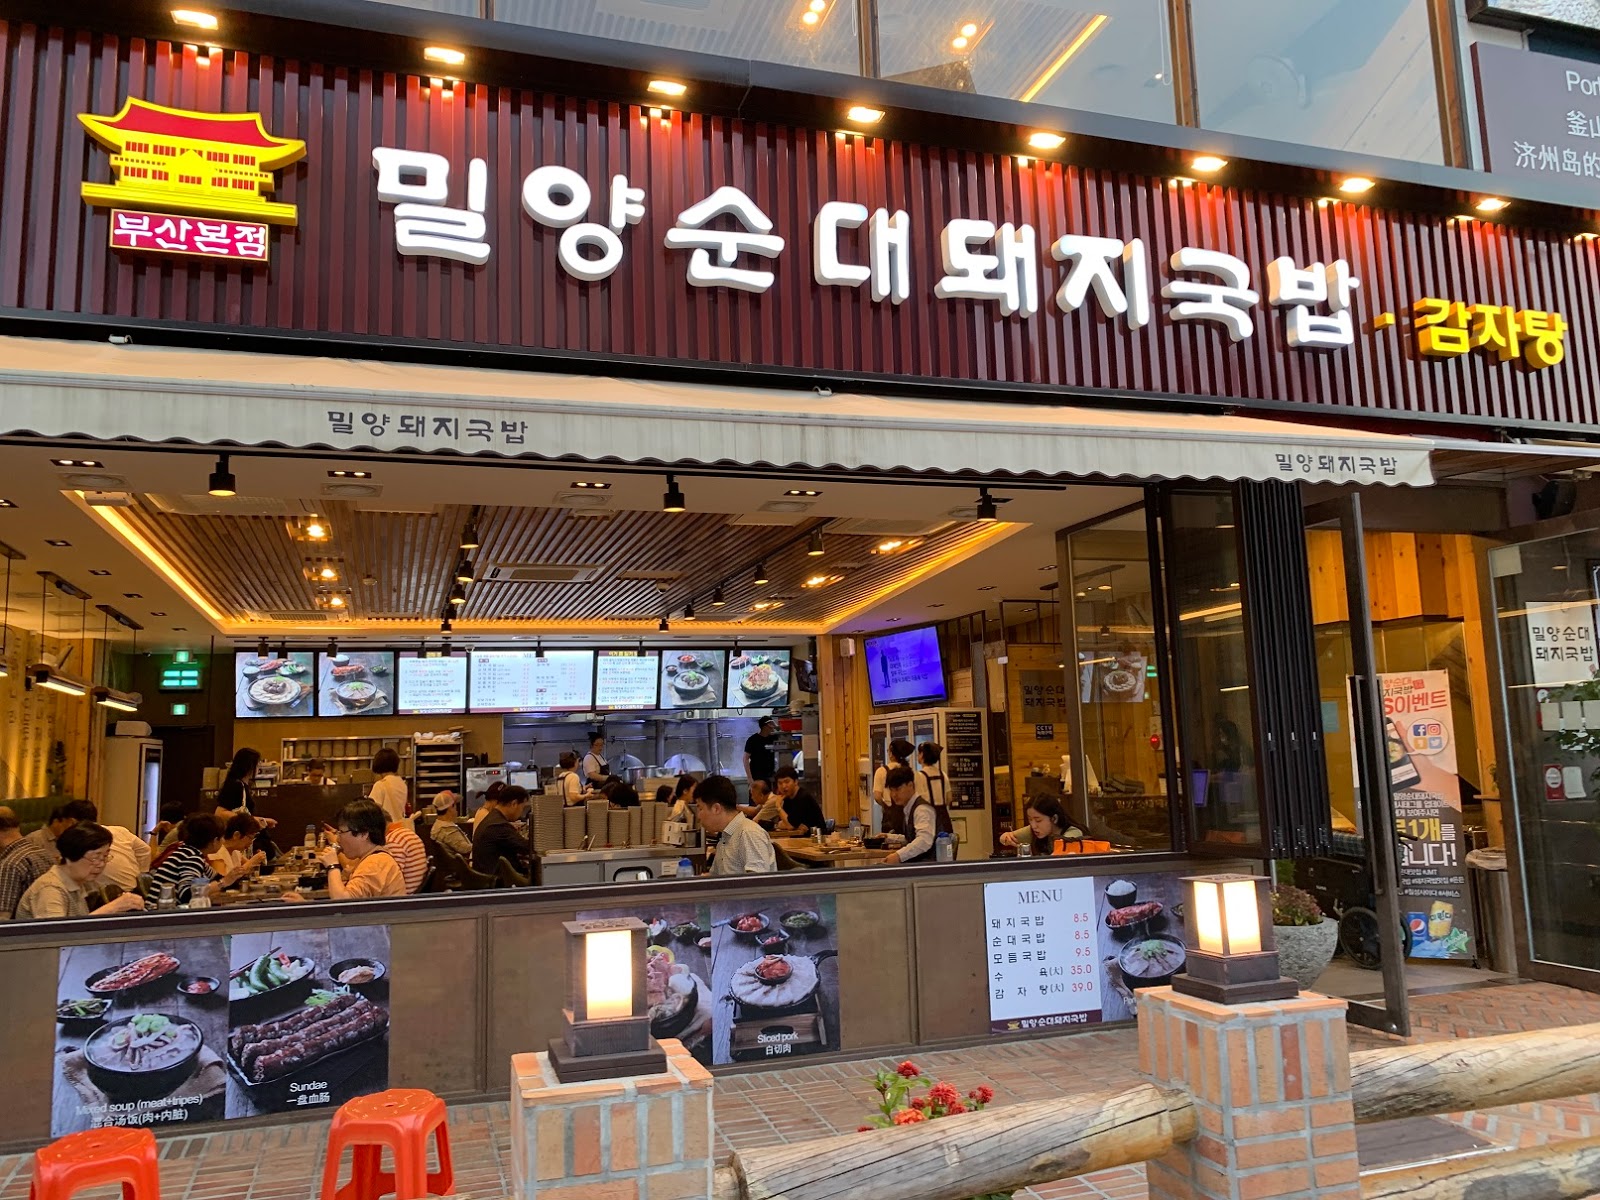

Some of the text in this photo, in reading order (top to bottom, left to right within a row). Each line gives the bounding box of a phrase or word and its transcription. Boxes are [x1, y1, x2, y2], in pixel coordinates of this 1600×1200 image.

[1513, 141, 1600, 179] 济州岛的
[114, 213, 266, 257] 부산본점
[1412, 296, 1568, 371] 감자탕
[327, 411, 528, 444] 밀양돼지국밥
[1275, 453, 1398, 475] 밀양돼지국밥
[1532, 626, 1590, 642] 밀양순대
[1535, 646, 1594, 661] 돼지국밥
[1384, 676, 1412, 688] 양순대
[1383, 685, 1413, 697] 지국밥
[1384, 690, 1448, 715] S이벤트
[1018, 888, 1064, 904] MENU
[1073, 913, 1089, 923] 8.5
[1074, 930, 1090, 940] 8.5
[1075, 947, 1091, 957] 9.5
[1070, 964, 1092, 975] 35.0
[1071, 981, 1093, 992] 39.0
[1020, 1013, 1088, 1029] 밀양순대돼지국밥
[757, 1031, 799, 1044] Sliced pork
[765, 1044, 792, 1055] 白切肉
[289, 1080, 328, 1093] Sundae
[109, 1101, 135, 1115] soup
[137, 1093, 204, 1112] (meat+tripes)
[286, 1093, 331, 1105] 一盘血肠
